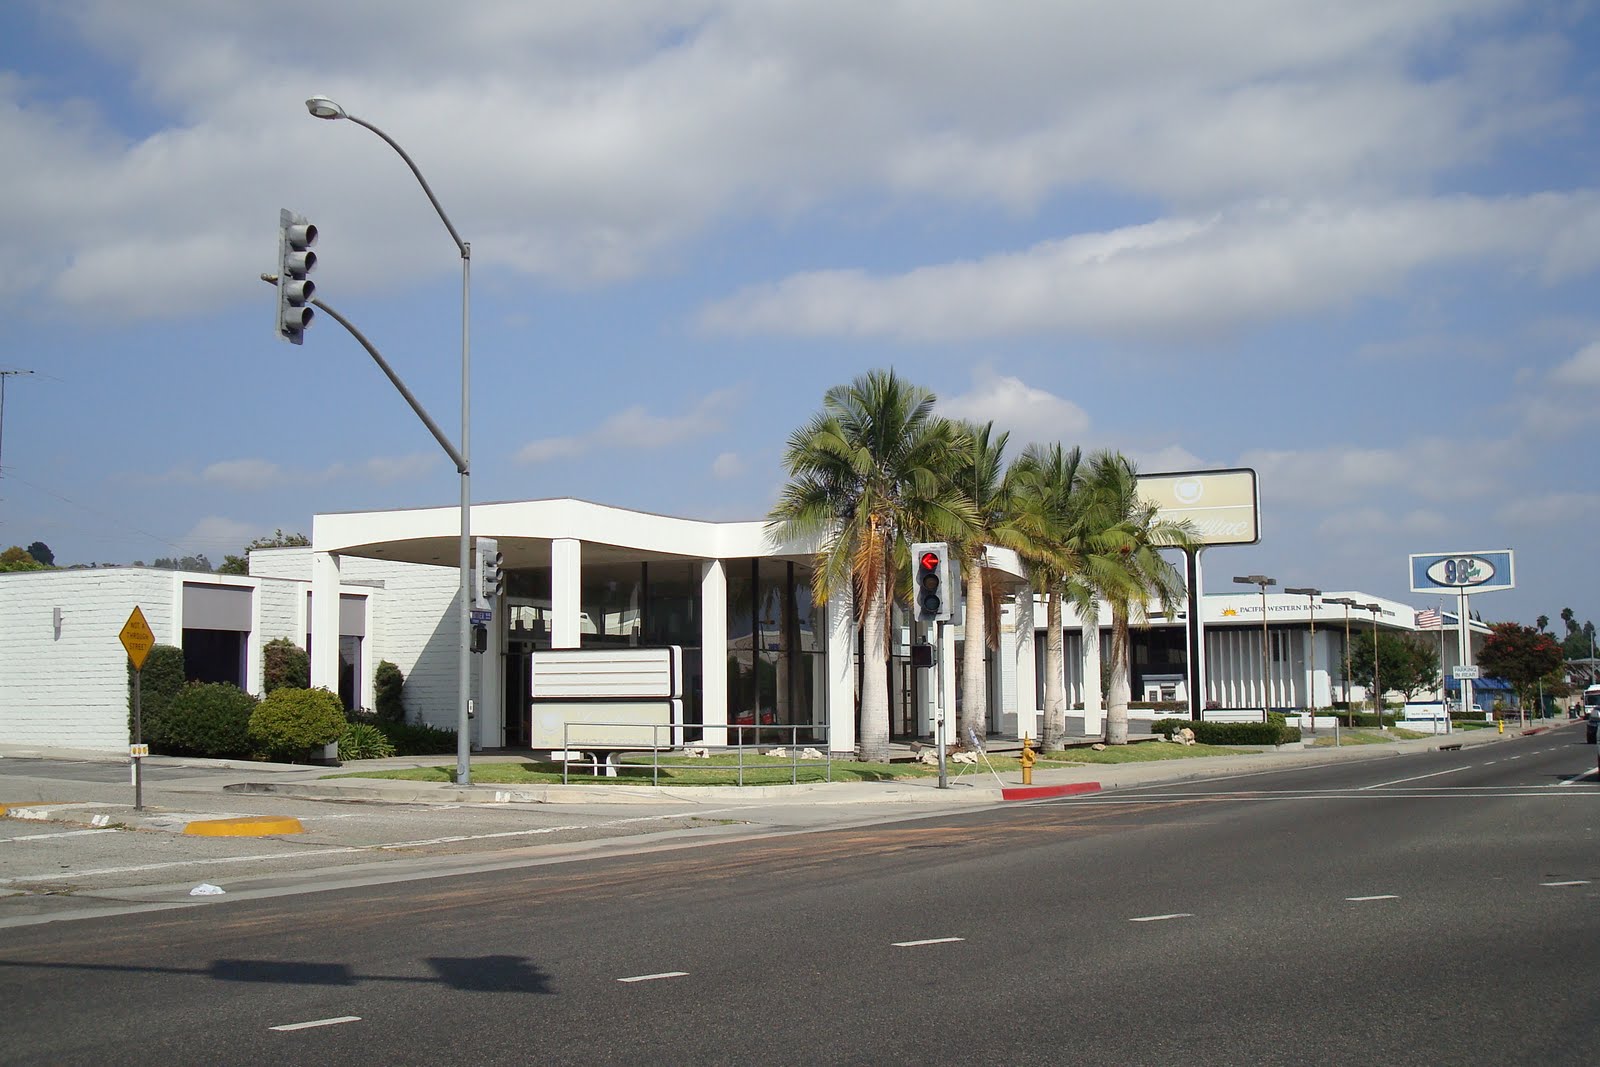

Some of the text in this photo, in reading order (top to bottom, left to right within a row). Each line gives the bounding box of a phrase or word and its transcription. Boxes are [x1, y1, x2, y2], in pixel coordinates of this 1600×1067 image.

[1267, 604, 1302, 612] WESTERN
[130, 621, 140, 629] NOT
[126, 631, 149, 640] THROUGH
[129, 642, 147, 651] STREET
